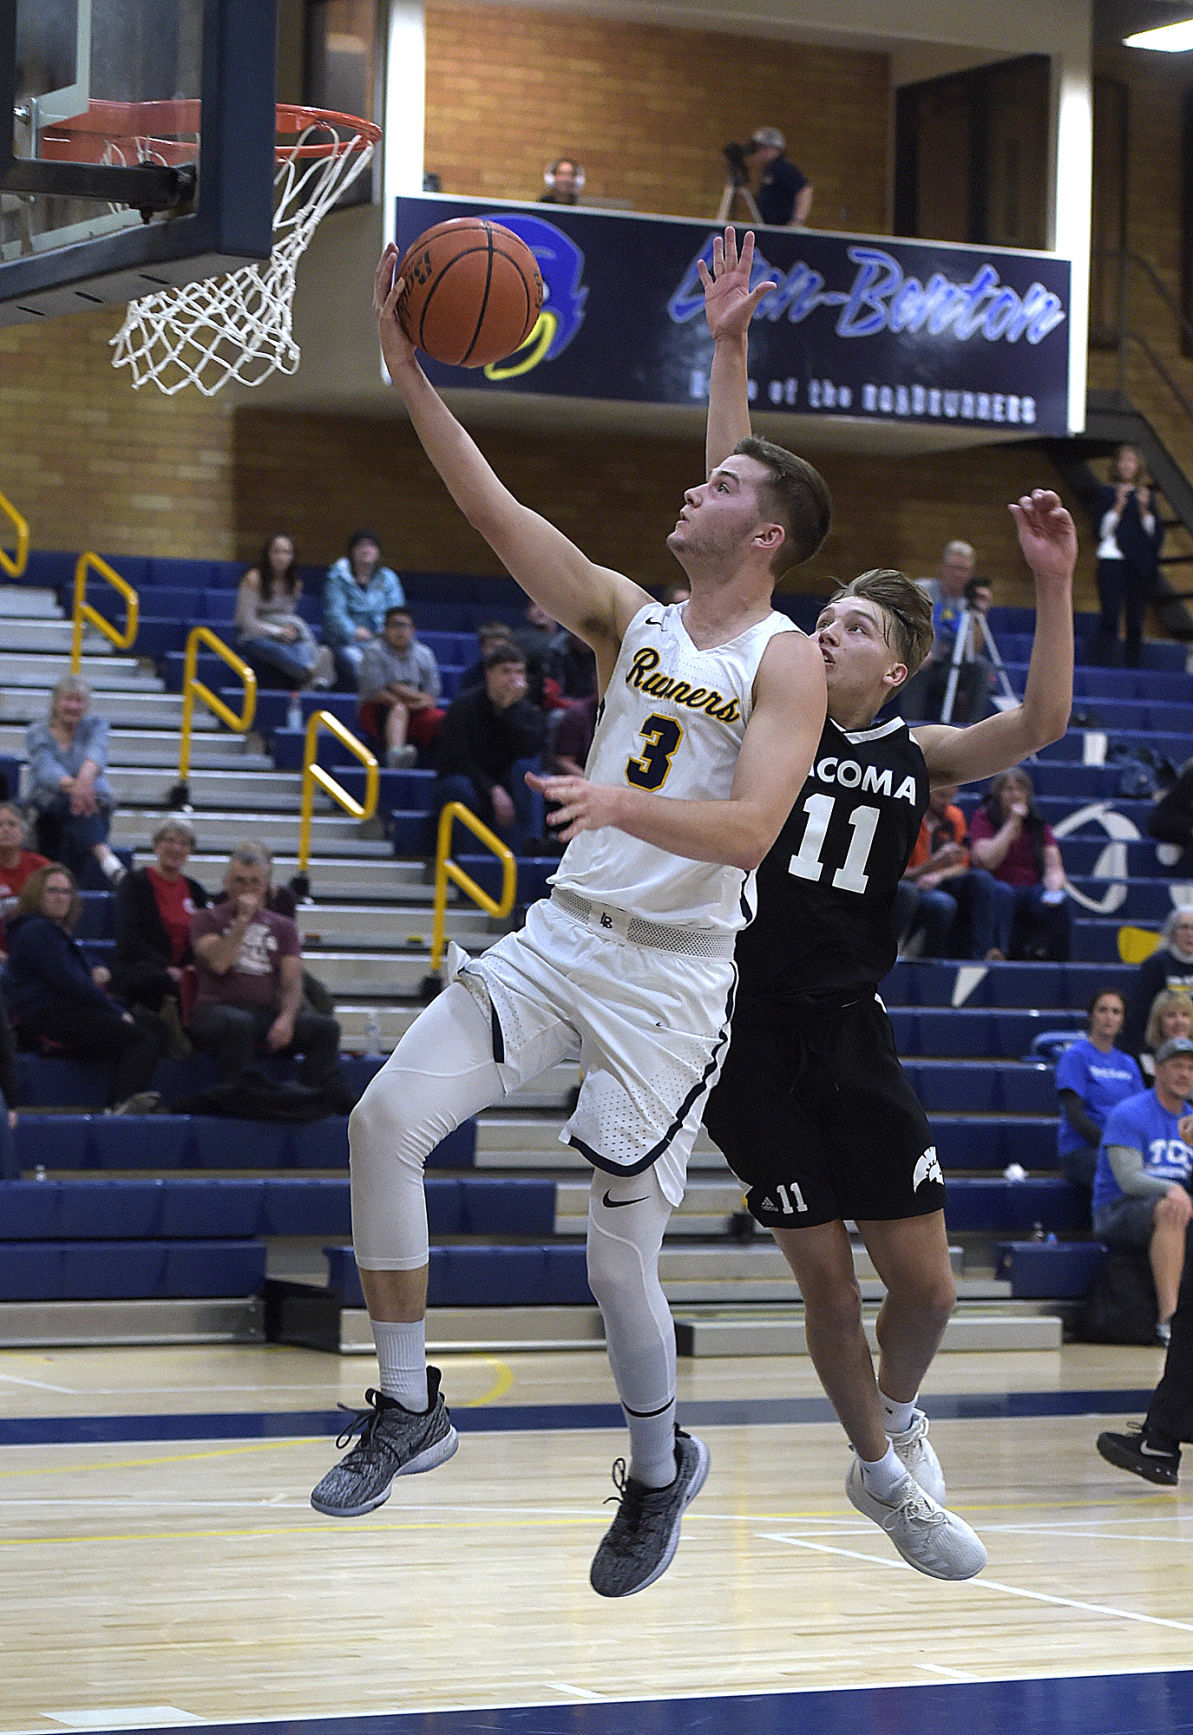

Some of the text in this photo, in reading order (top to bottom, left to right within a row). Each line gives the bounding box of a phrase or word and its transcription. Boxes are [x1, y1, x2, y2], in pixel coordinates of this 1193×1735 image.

[809, 378, 852, 408] the
[624, 712, 684, 793] 3
[808, 756, 916, 806] COMA
[788, 793, 880, 894] 11
[776, 1182, 808, 1214] 11
